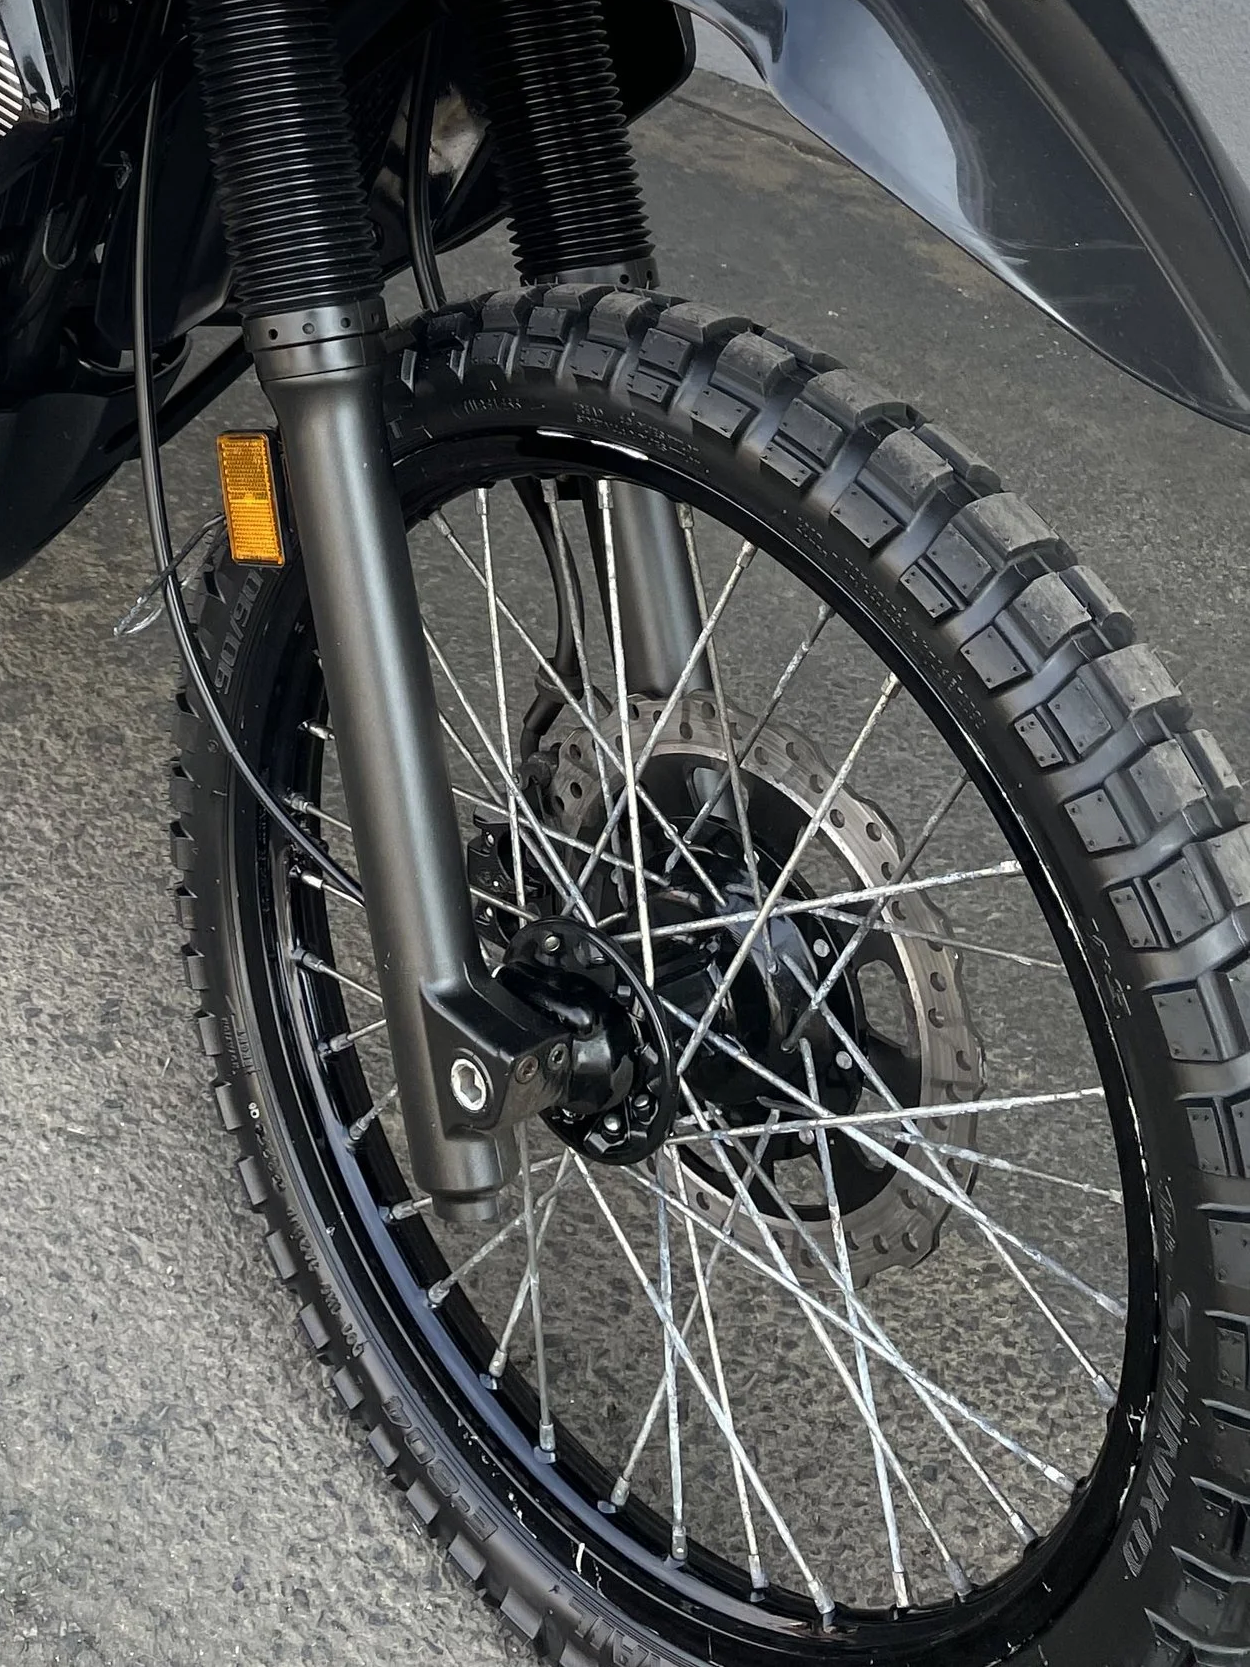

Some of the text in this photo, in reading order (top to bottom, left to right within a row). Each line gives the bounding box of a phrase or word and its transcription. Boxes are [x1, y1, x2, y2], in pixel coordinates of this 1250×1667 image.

[214, 568, 265, 695] 90/90
[381, 1395, 498, 1542] E-804
[1123, 1291, 1191, 1577] SHINKO
